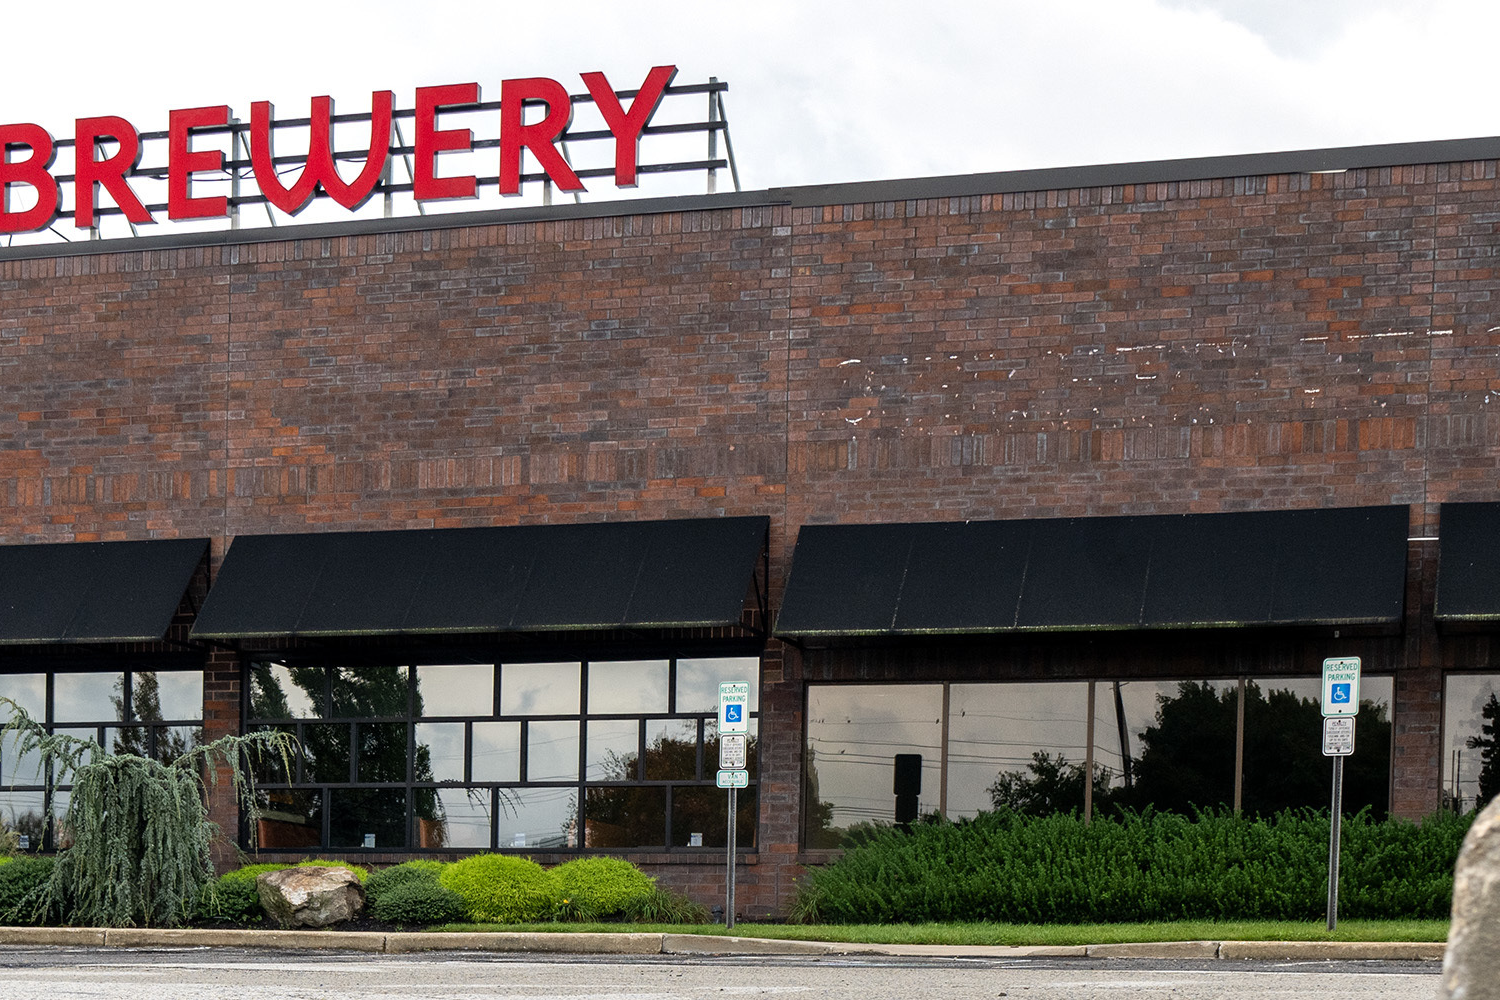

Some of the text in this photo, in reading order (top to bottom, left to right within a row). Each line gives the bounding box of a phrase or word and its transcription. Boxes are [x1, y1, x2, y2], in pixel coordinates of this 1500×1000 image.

[1326, 663, 1358, 672] RESERVED
[1327, 673, 1356, 681] PARKING
[720, 686, 747, 694] RESERVED
